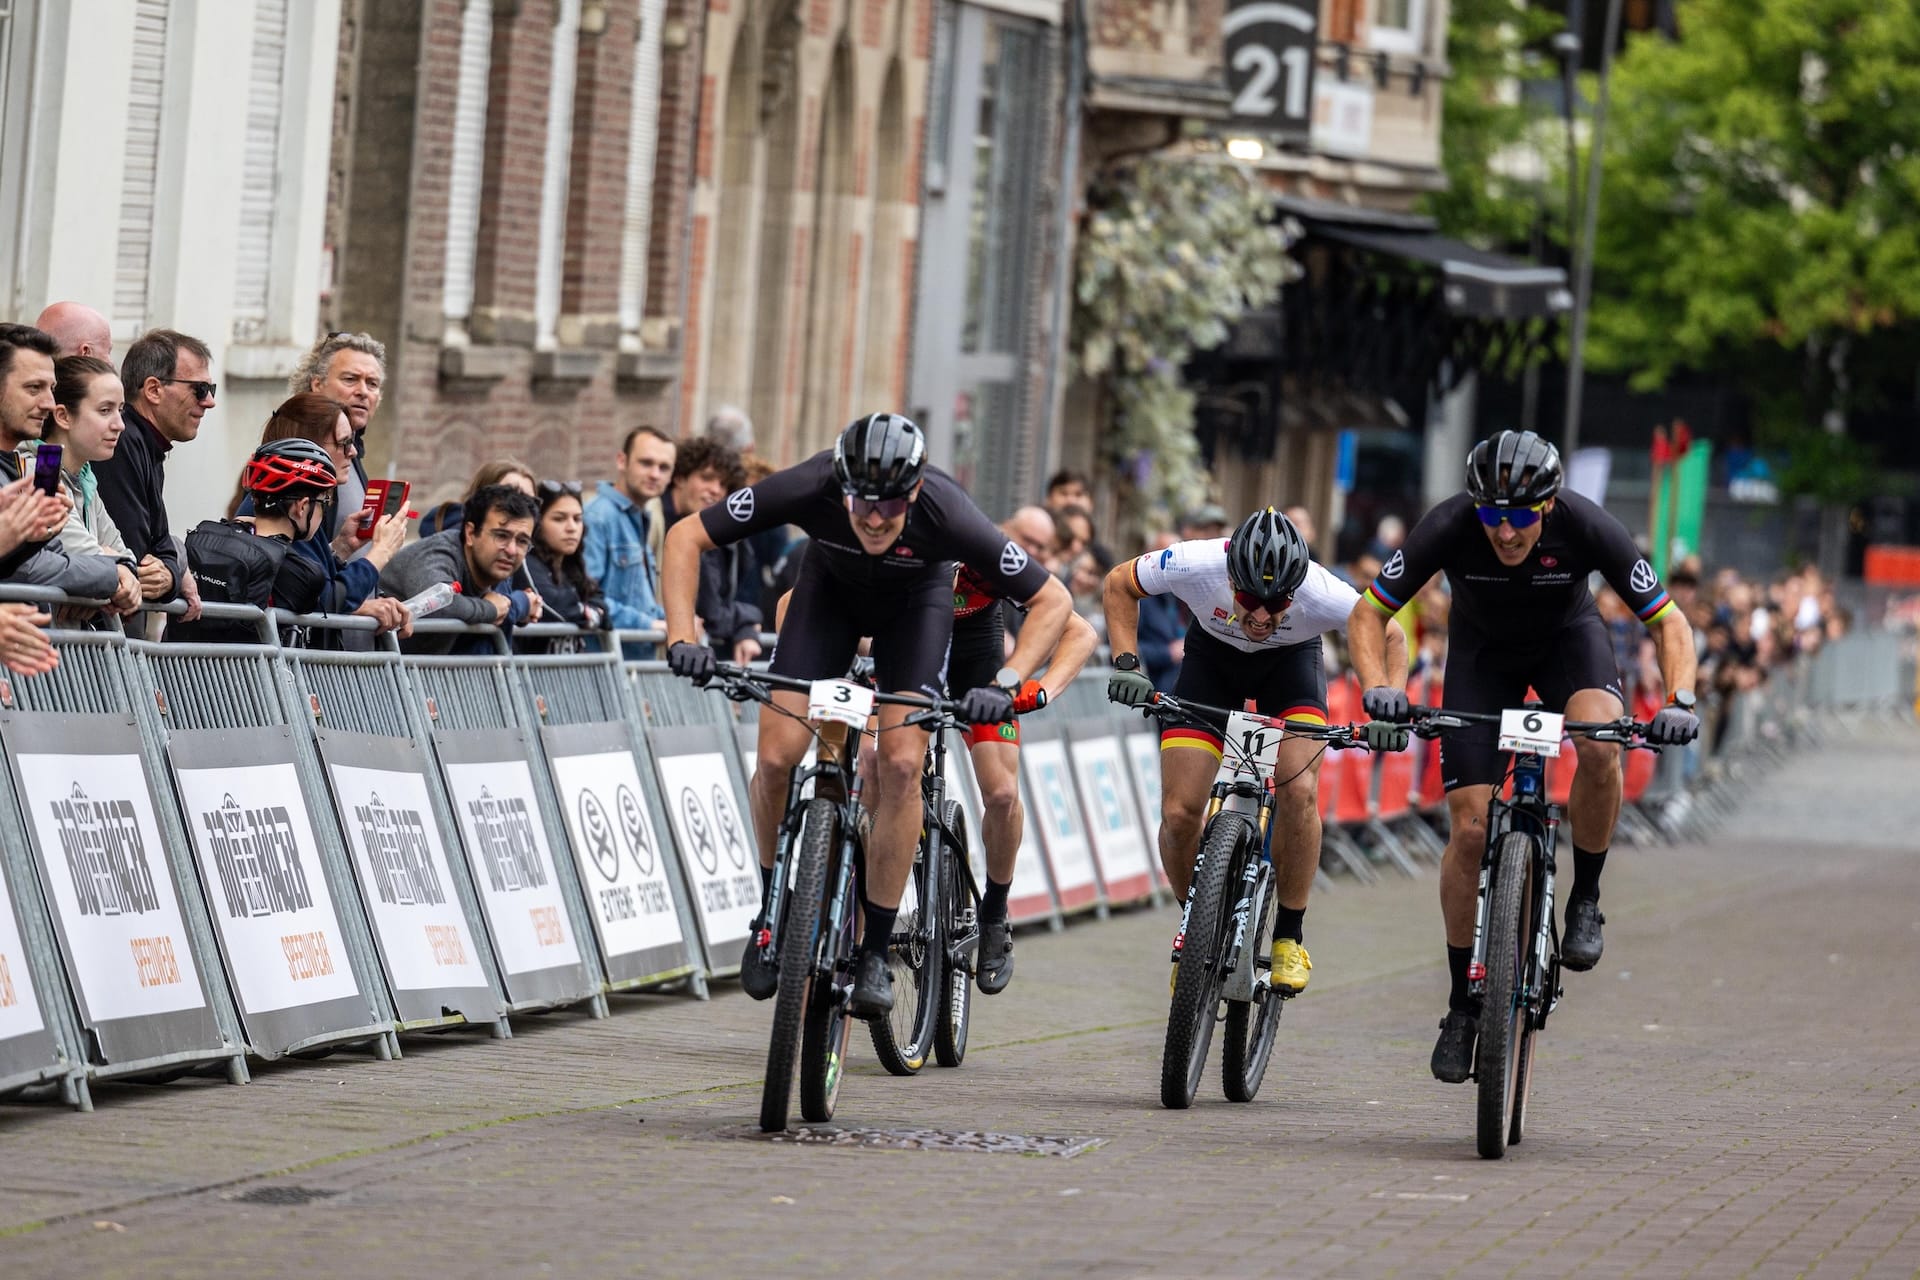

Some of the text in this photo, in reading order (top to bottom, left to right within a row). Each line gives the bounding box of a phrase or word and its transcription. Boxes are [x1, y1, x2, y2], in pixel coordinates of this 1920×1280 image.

[230, 44, 310, 119] 21
[201, 574, 227, 587] VAUDE
[833, 685, 851, 702] 3
[1523, 712, 1543, 733] 6
[1242, 730, 1265, 757] 11
[130, 936, 181, 988] SPEEDWEAR
[280, 931, 334, 982] SPEEDWEAR
